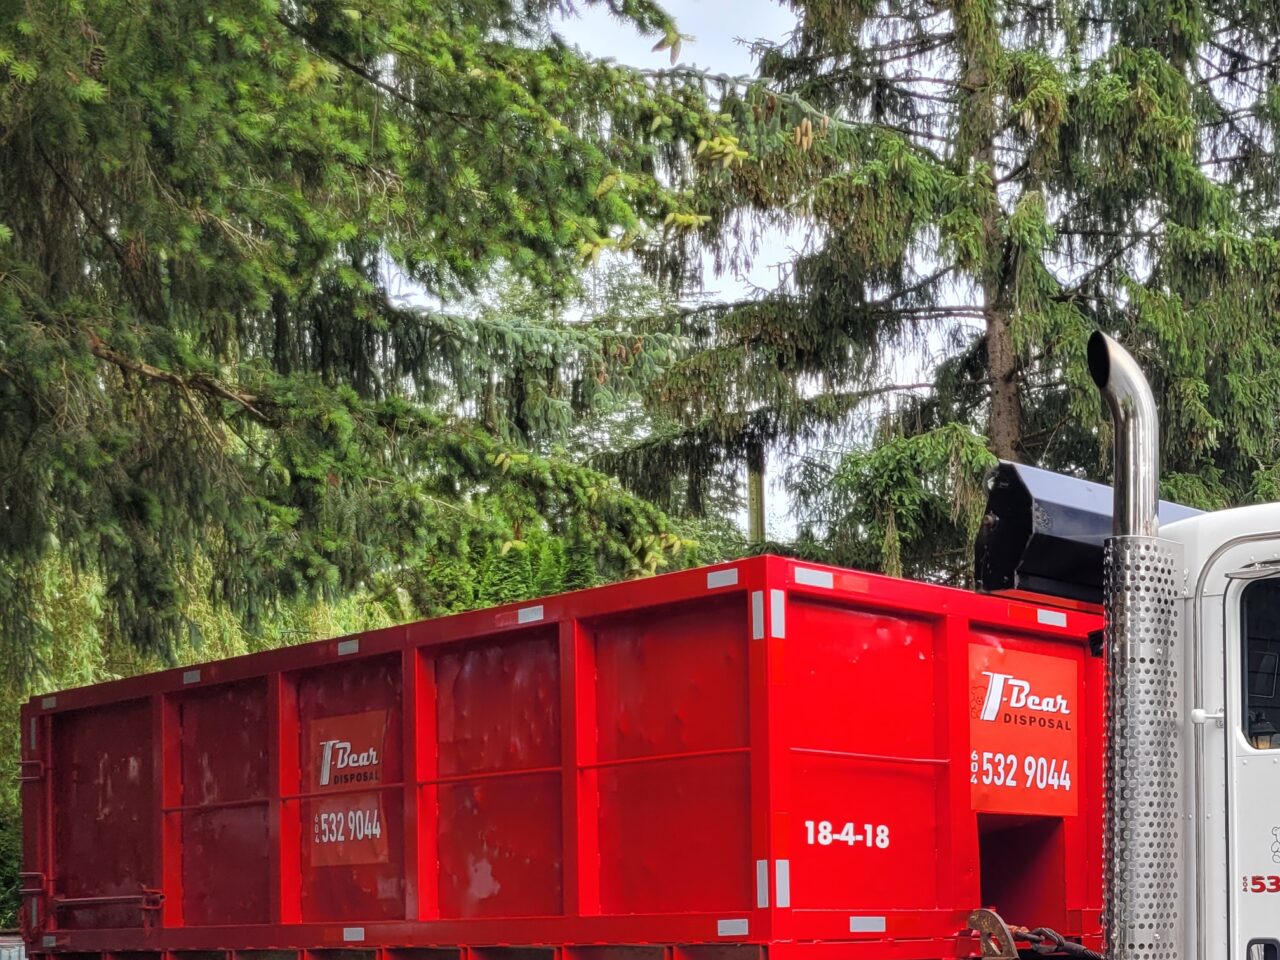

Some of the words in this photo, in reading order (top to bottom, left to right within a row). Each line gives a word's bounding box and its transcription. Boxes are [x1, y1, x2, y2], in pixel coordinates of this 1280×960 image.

[1003, 713, 1072, 731] DISPOSAL
[333, 772, 379, 785] DISPOSAL
[970, 750, 979, 785] 604
[982, 751, 1018, 787] 532
[1023, 755, 1071, 791] 9044
[321, 812, 345, 843] 532
[348, 808, 381, 840] 9044
[804, 820, 890, 849] 18-4-18
